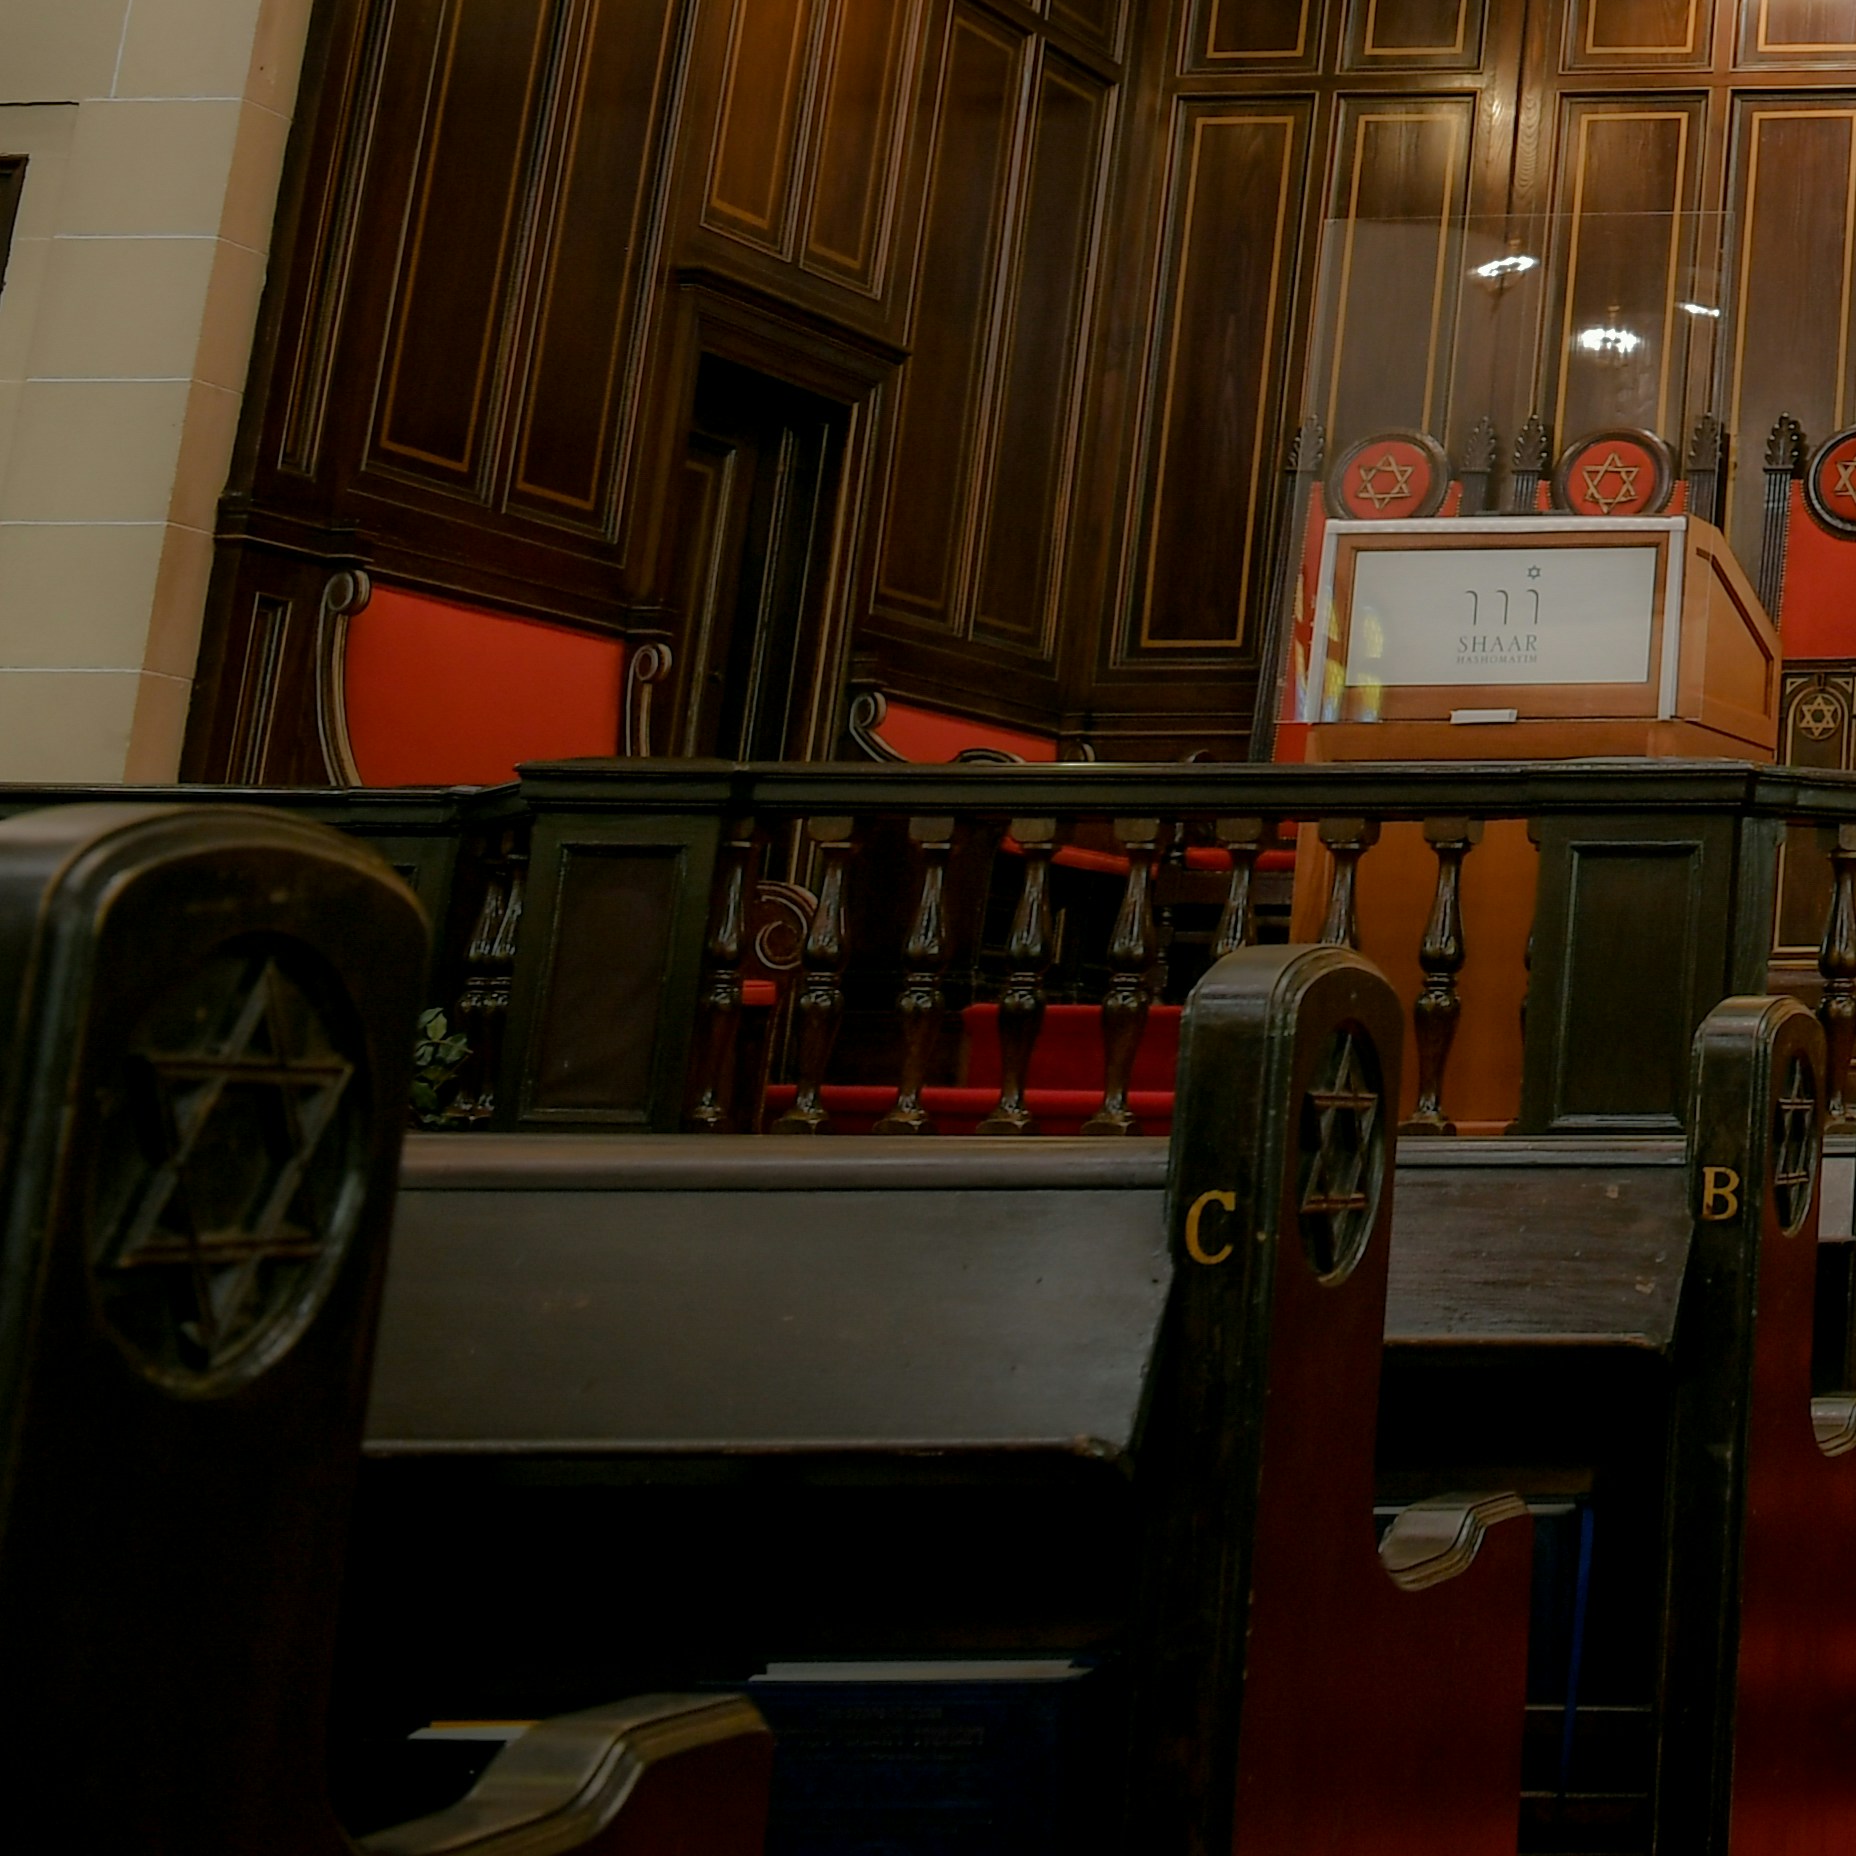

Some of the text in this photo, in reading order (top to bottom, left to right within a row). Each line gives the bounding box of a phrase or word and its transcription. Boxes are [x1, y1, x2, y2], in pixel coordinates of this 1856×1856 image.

[1458, 634, 1538, 653] SHAAR
[1702, 1166, 1741, 1221] B
[1185, 1189, 1237, 1265] C
